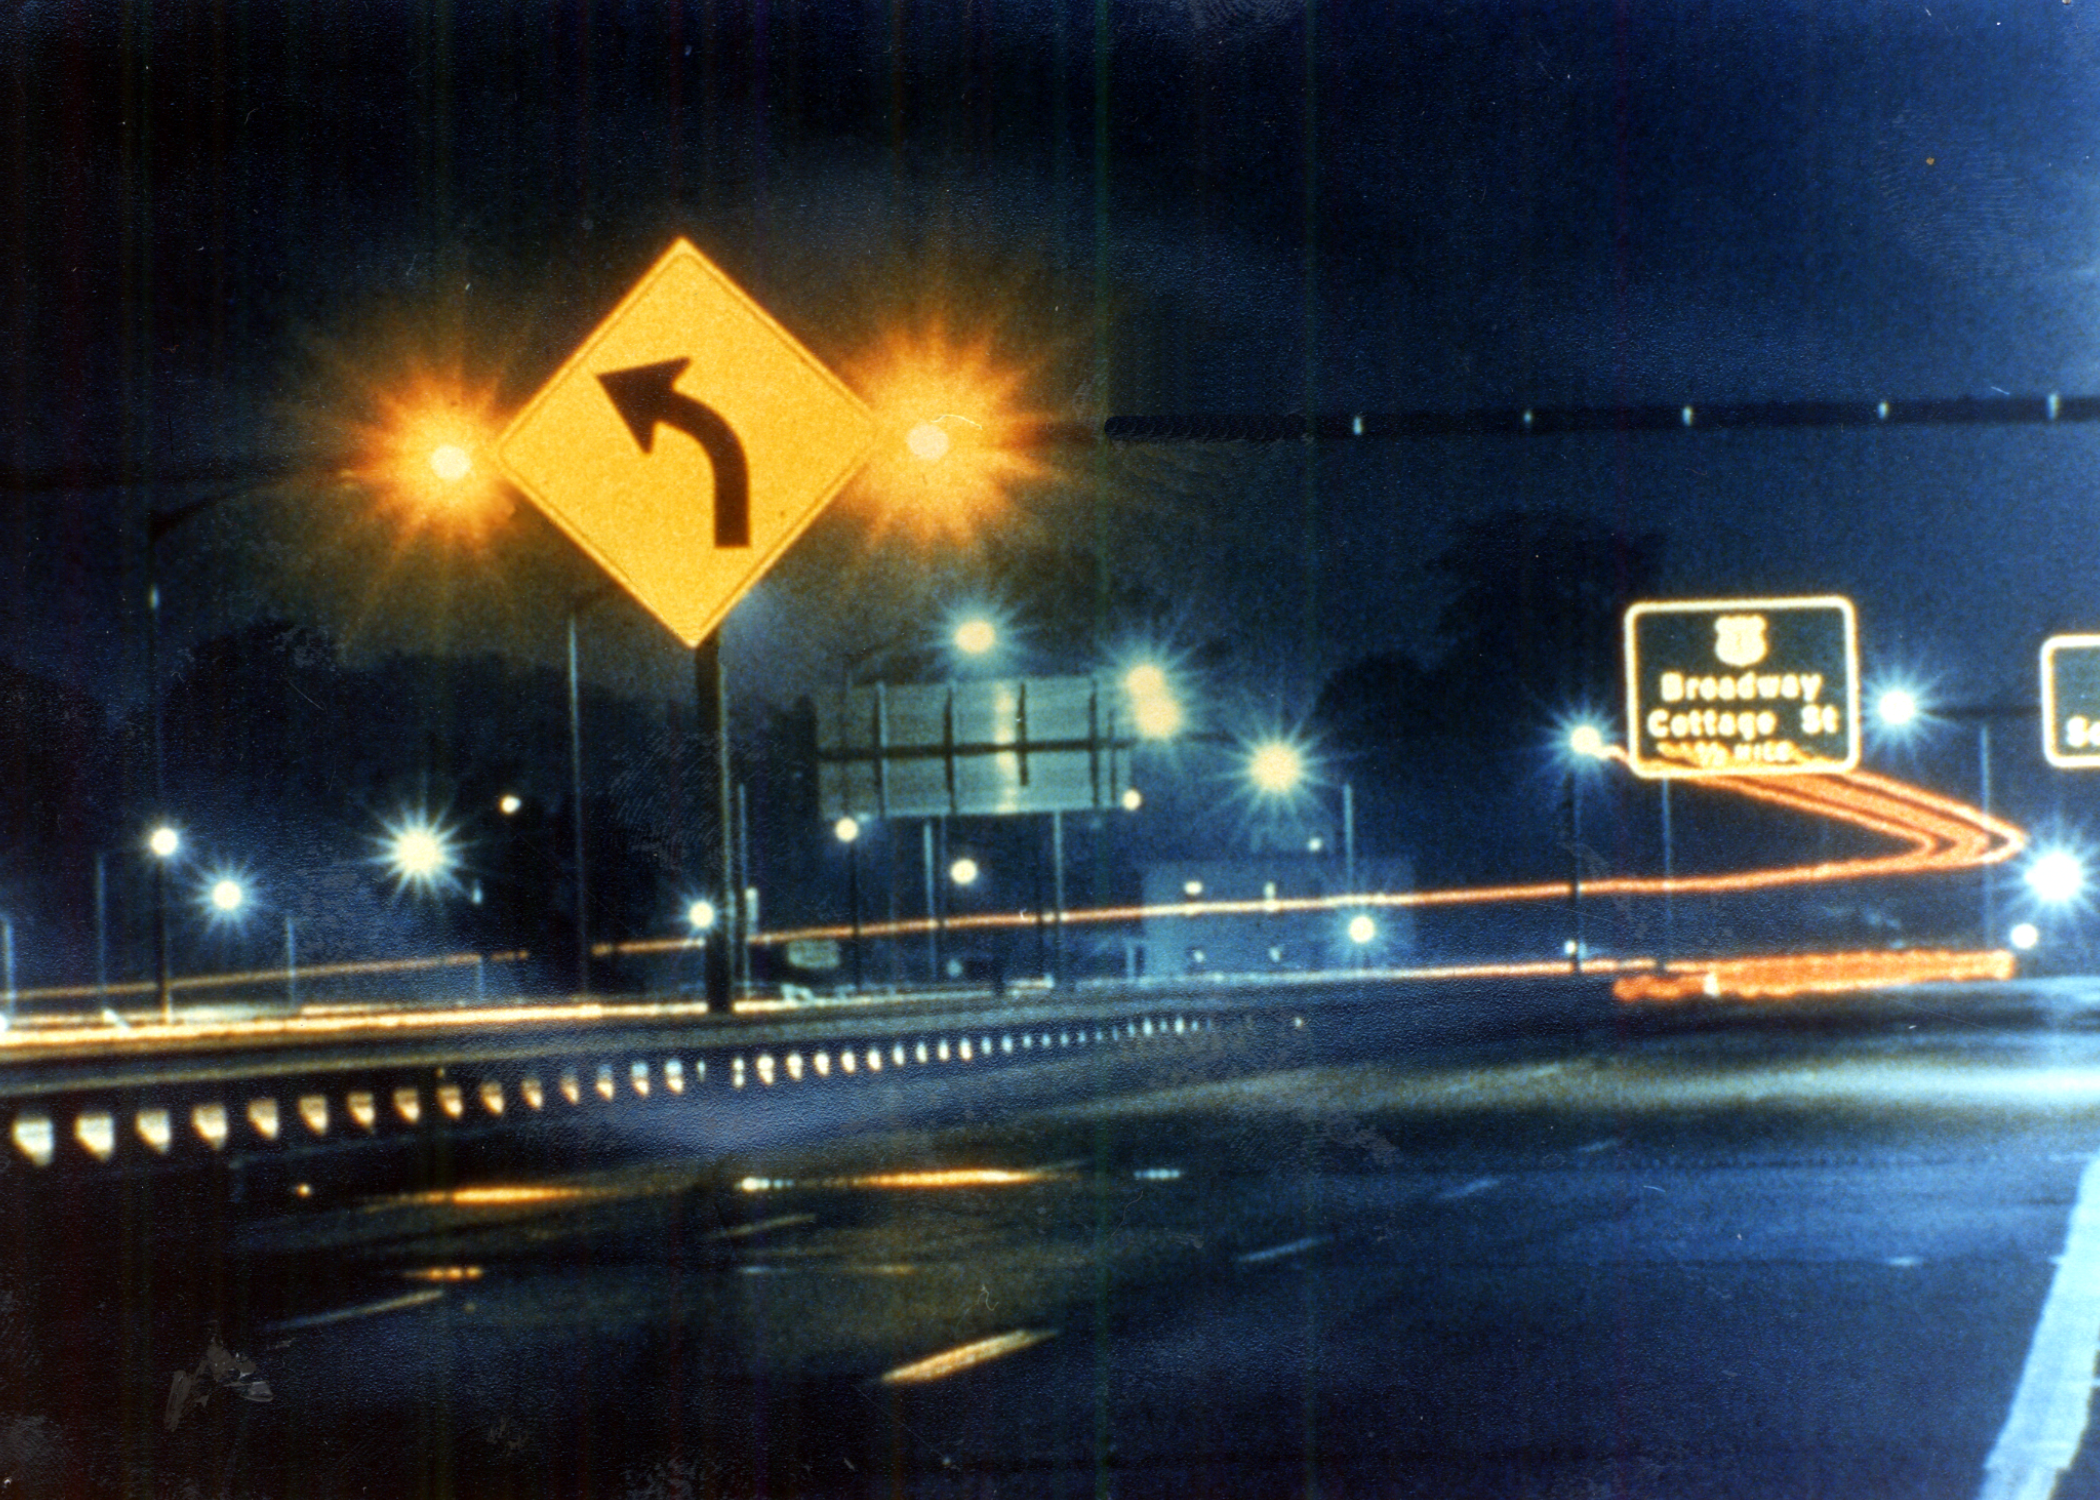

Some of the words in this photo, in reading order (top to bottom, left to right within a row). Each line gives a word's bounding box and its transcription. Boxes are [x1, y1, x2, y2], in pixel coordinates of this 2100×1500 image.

[1660, 671, 1822, 702] Broadway
[1647, 709, 1775, 741] Cottage
[1801, 704, 1837, 733] St
